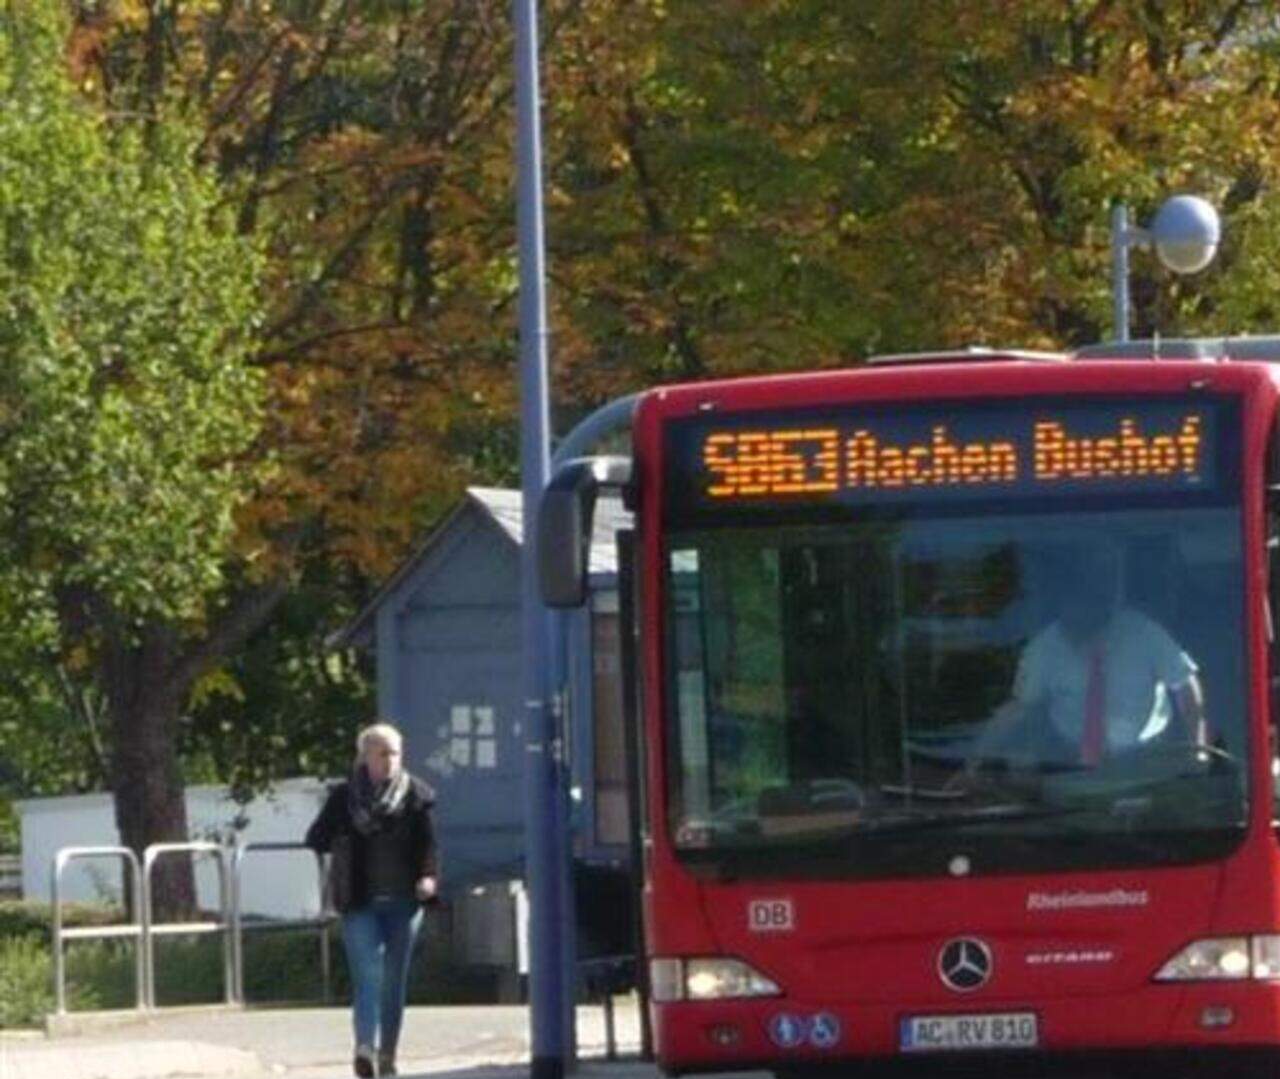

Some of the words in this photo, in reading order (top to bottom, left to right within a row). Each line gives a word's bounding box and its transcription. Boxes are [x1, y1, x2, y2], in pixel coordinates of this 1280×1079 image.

[847, 425, 1016, 487] Aachen
[1034, 415, 1200, 480] Bushof
[753, 902, 789, 926] DB
[917, 1021, 943, 1042] AC
[957, 1019, 986, 1041] RV
[991, 1017, 1034, 1042] 810
